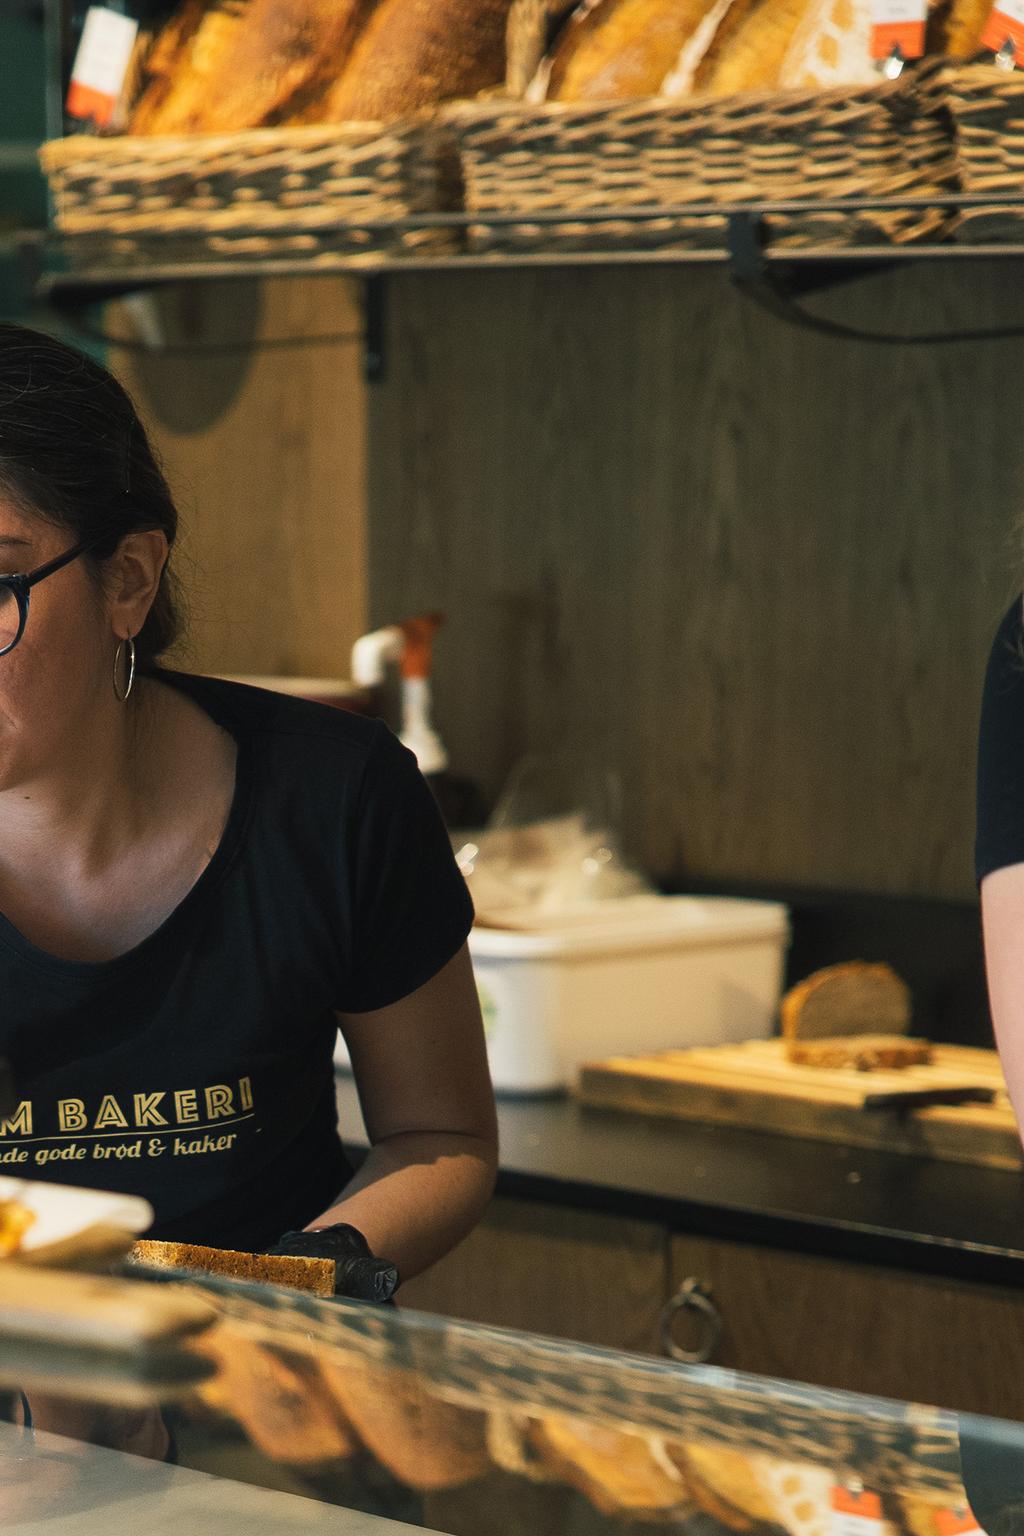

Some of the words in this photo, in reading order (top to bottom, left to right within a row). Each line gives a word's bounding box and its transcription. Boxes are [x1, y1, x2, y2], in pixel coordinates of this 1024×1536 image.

[58, 1076, 255, 1132] BAKERI
[35, 1144, 86, 1165] gode
[93, 1140, 142, 1160] brød
[148, 1138, 166, 1158] &
[173, 1134, 237, 1156] kaker
